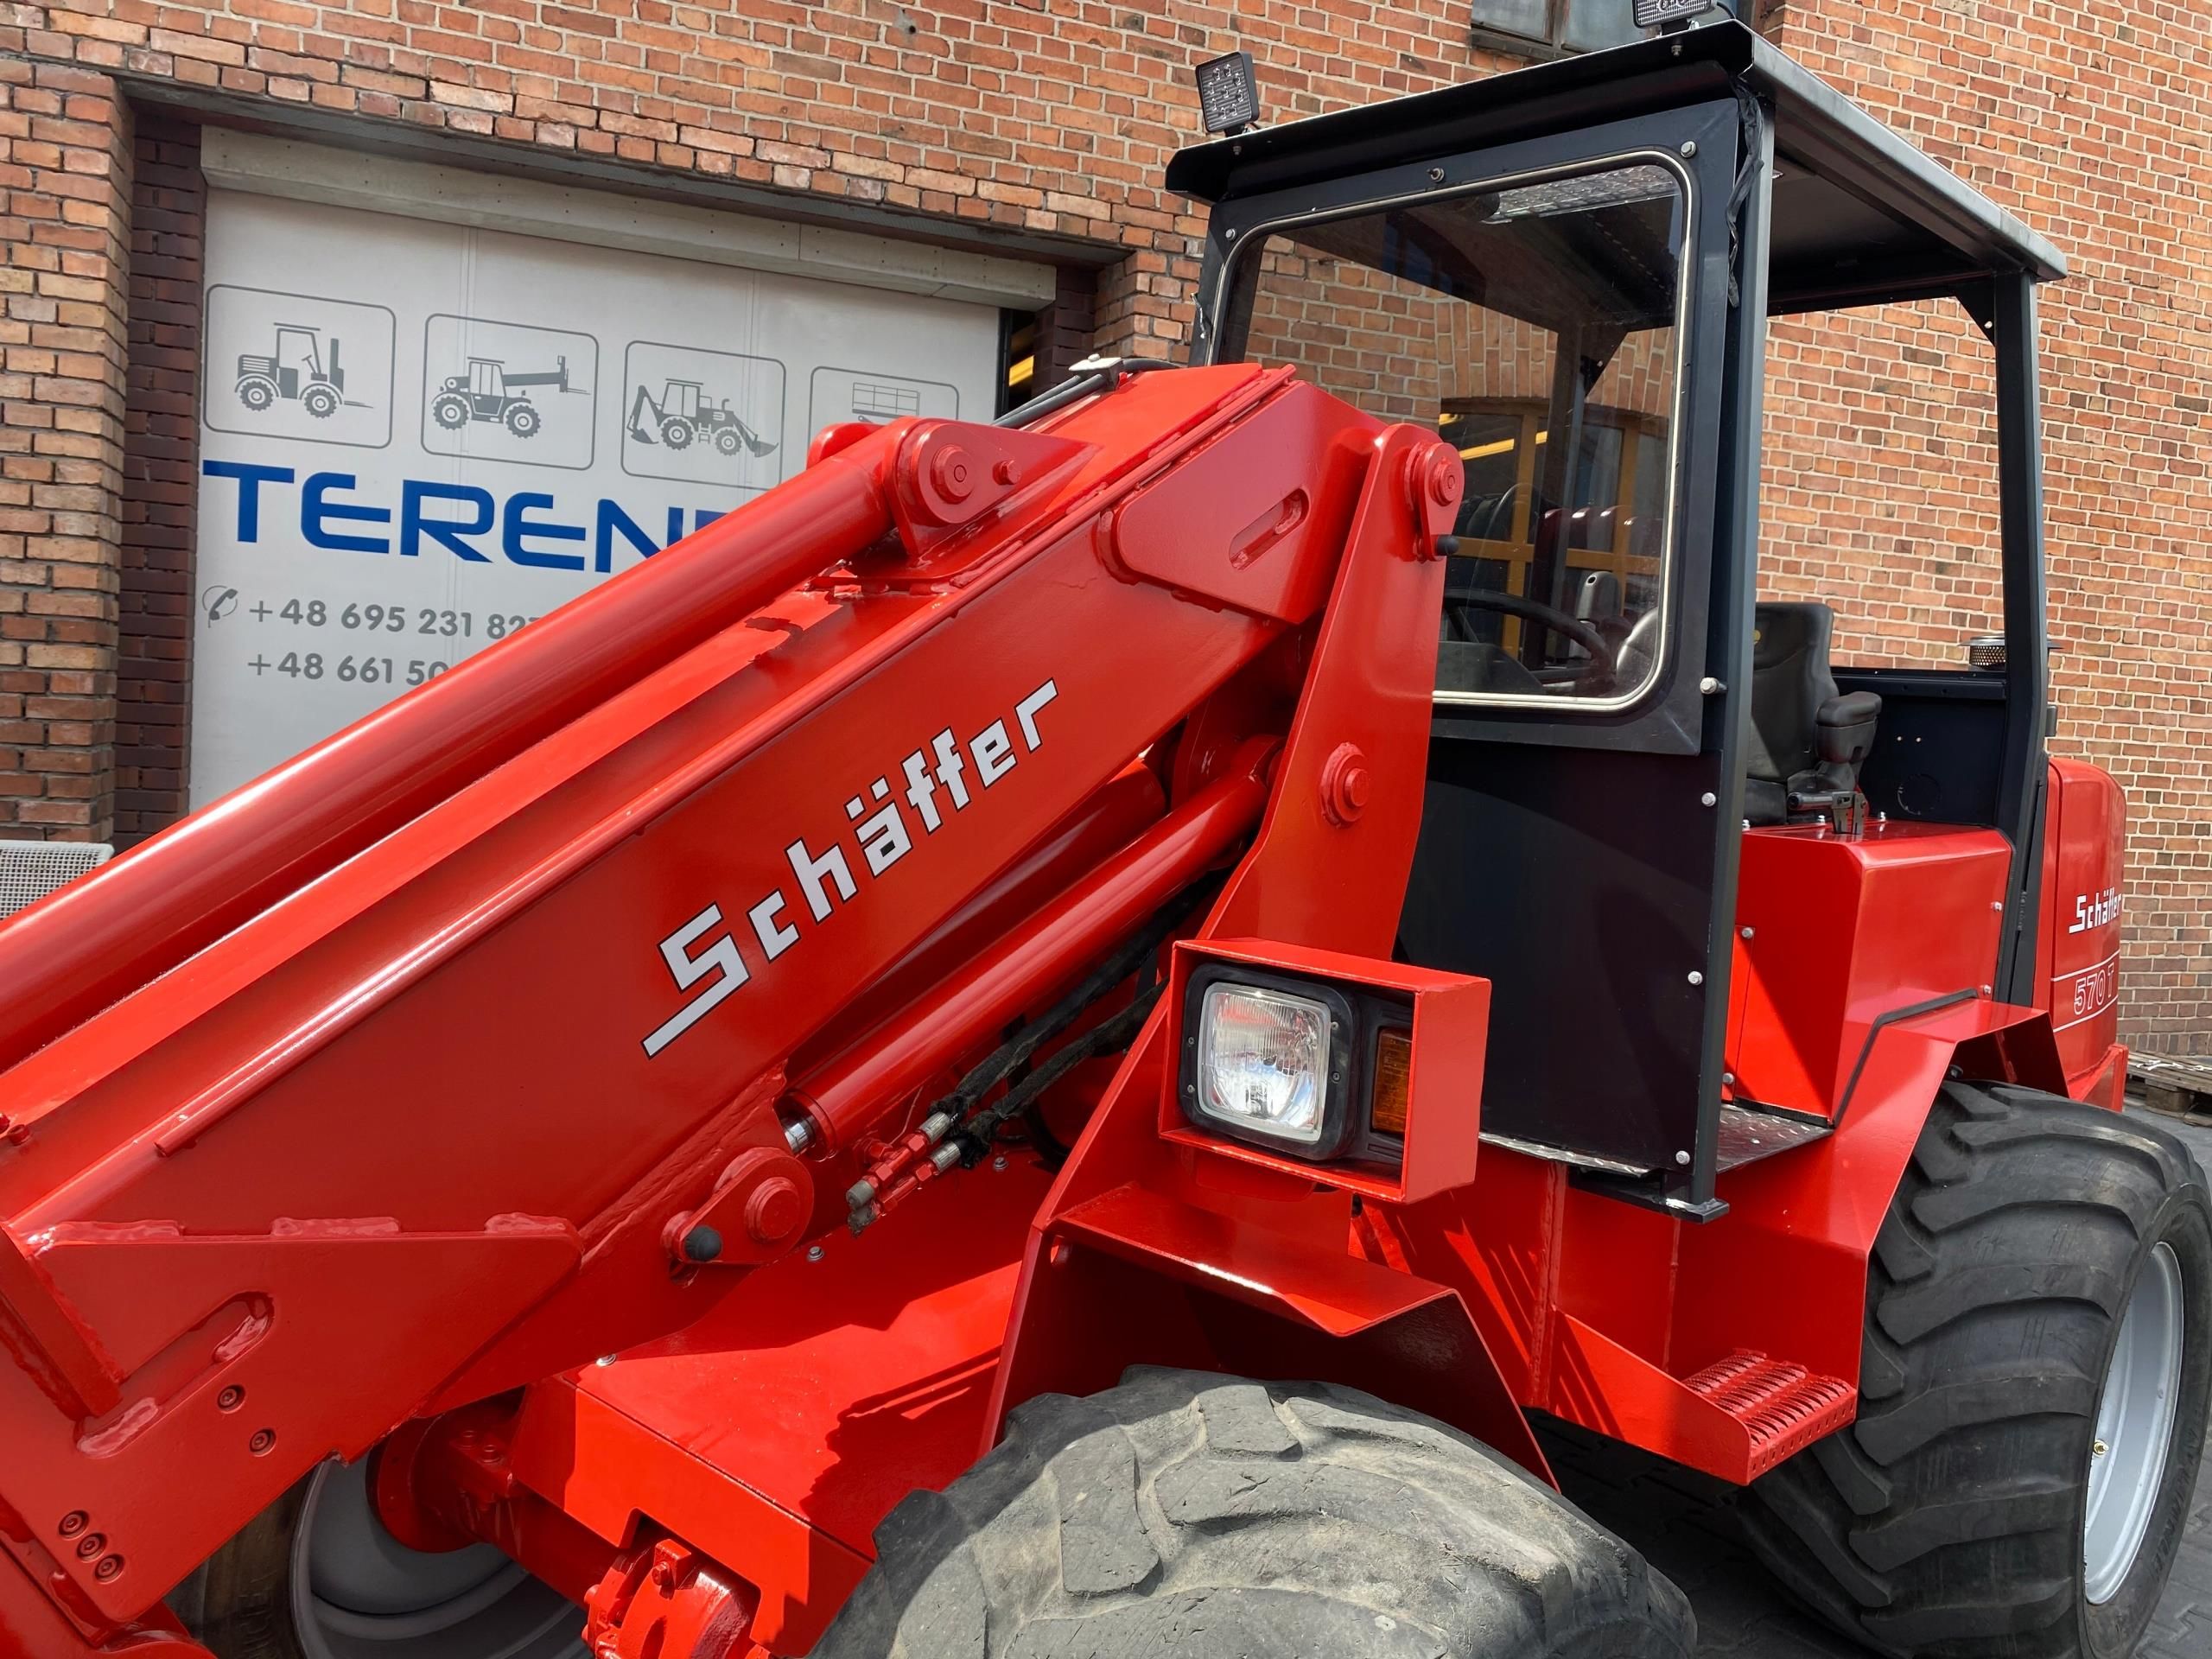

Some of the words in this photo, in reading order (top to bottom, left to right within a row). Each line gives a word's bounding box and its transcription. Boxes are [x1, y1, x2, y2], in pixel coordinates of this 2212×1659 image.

[202, 460, 731, 574] TEREN
[249, 599, 327, 627] +48
[341, 603, 405, 632] 695
[418, 609, 472, 638] 231
[486, 613, 541, 639] 82
[247, 652, 324, 680] +48
[337, 655, 393, 684] 661
[640, 677, 1059, 1059] Schäffer
[2069, 887, 2122, 934] Schäffer
[2074, 969, 2106, 1015] 570
